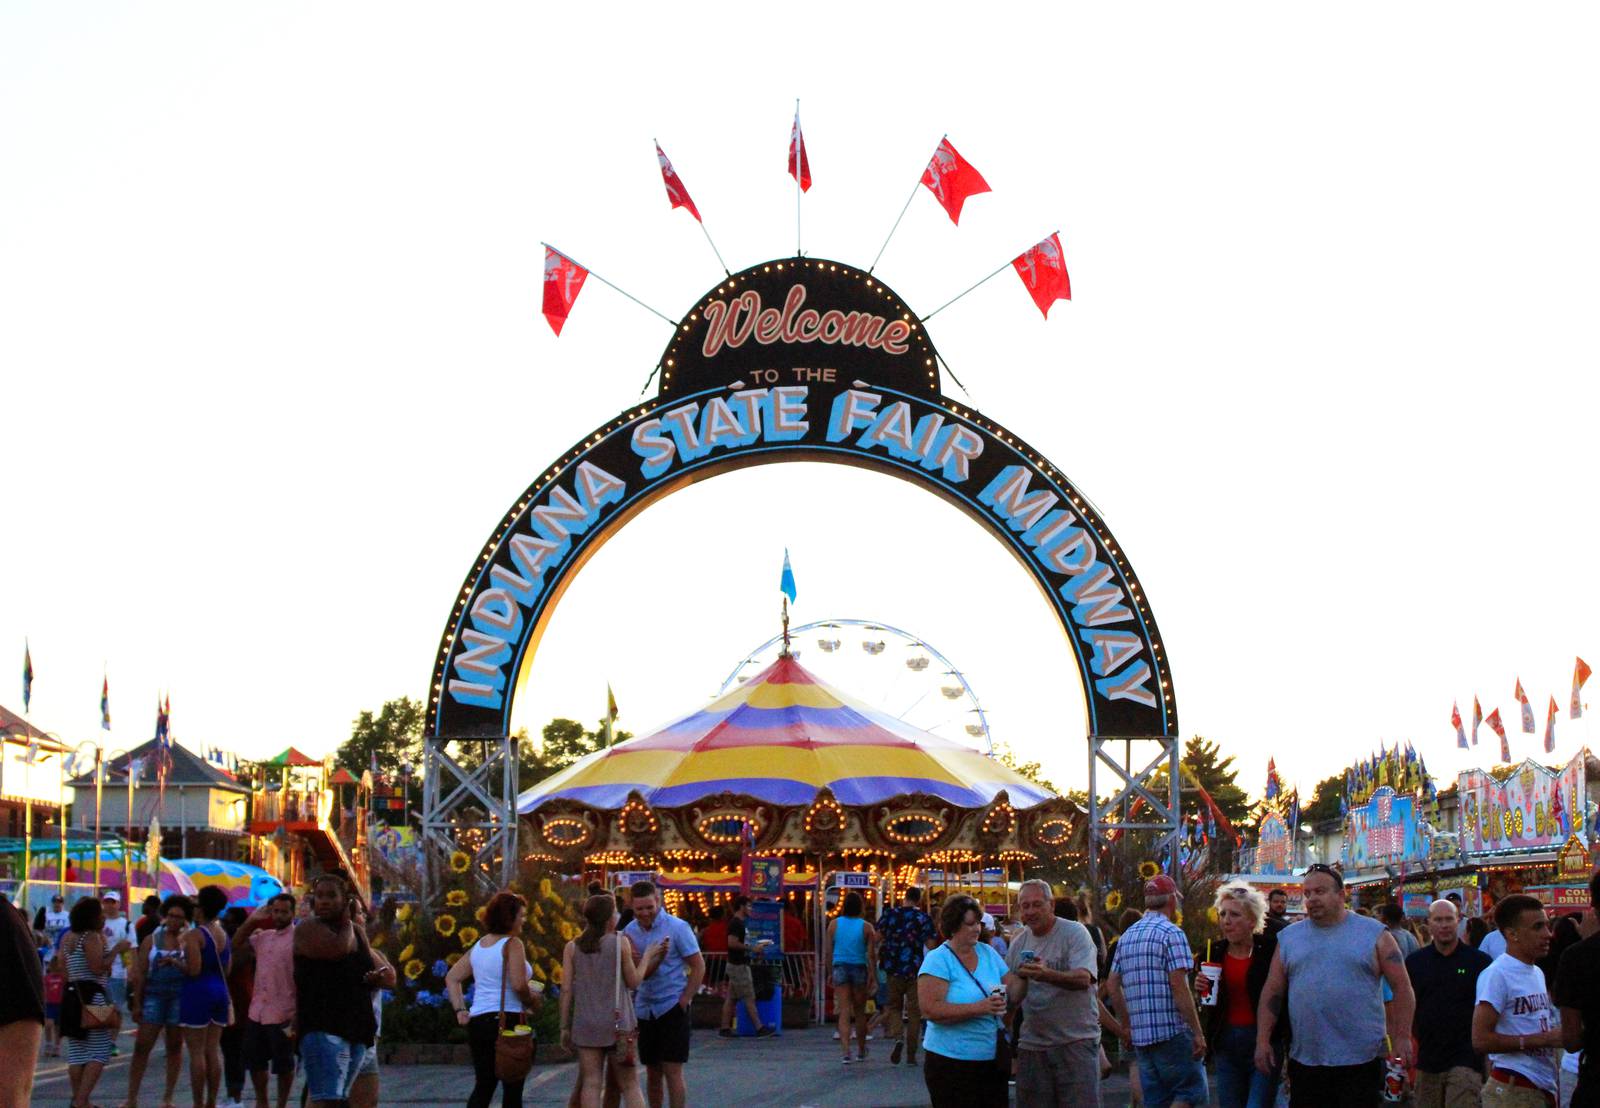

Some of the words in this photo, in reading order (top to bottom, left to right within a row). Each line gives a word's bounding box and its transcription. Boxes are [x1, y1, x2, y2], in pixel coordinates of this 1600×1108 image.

[702, 284, 910, 357] Welcome
[750, 369, 779, 384] TO
[792, 367, 836, 383] THE
[448, 460, 626, 709] INDIANA
[631, 386, 809, 480] STATE
[826, 389, 985, 483] FAIR
[976, 465, 1158, 708] MIDWAY
[1565, 889, 1593, 897] COL
